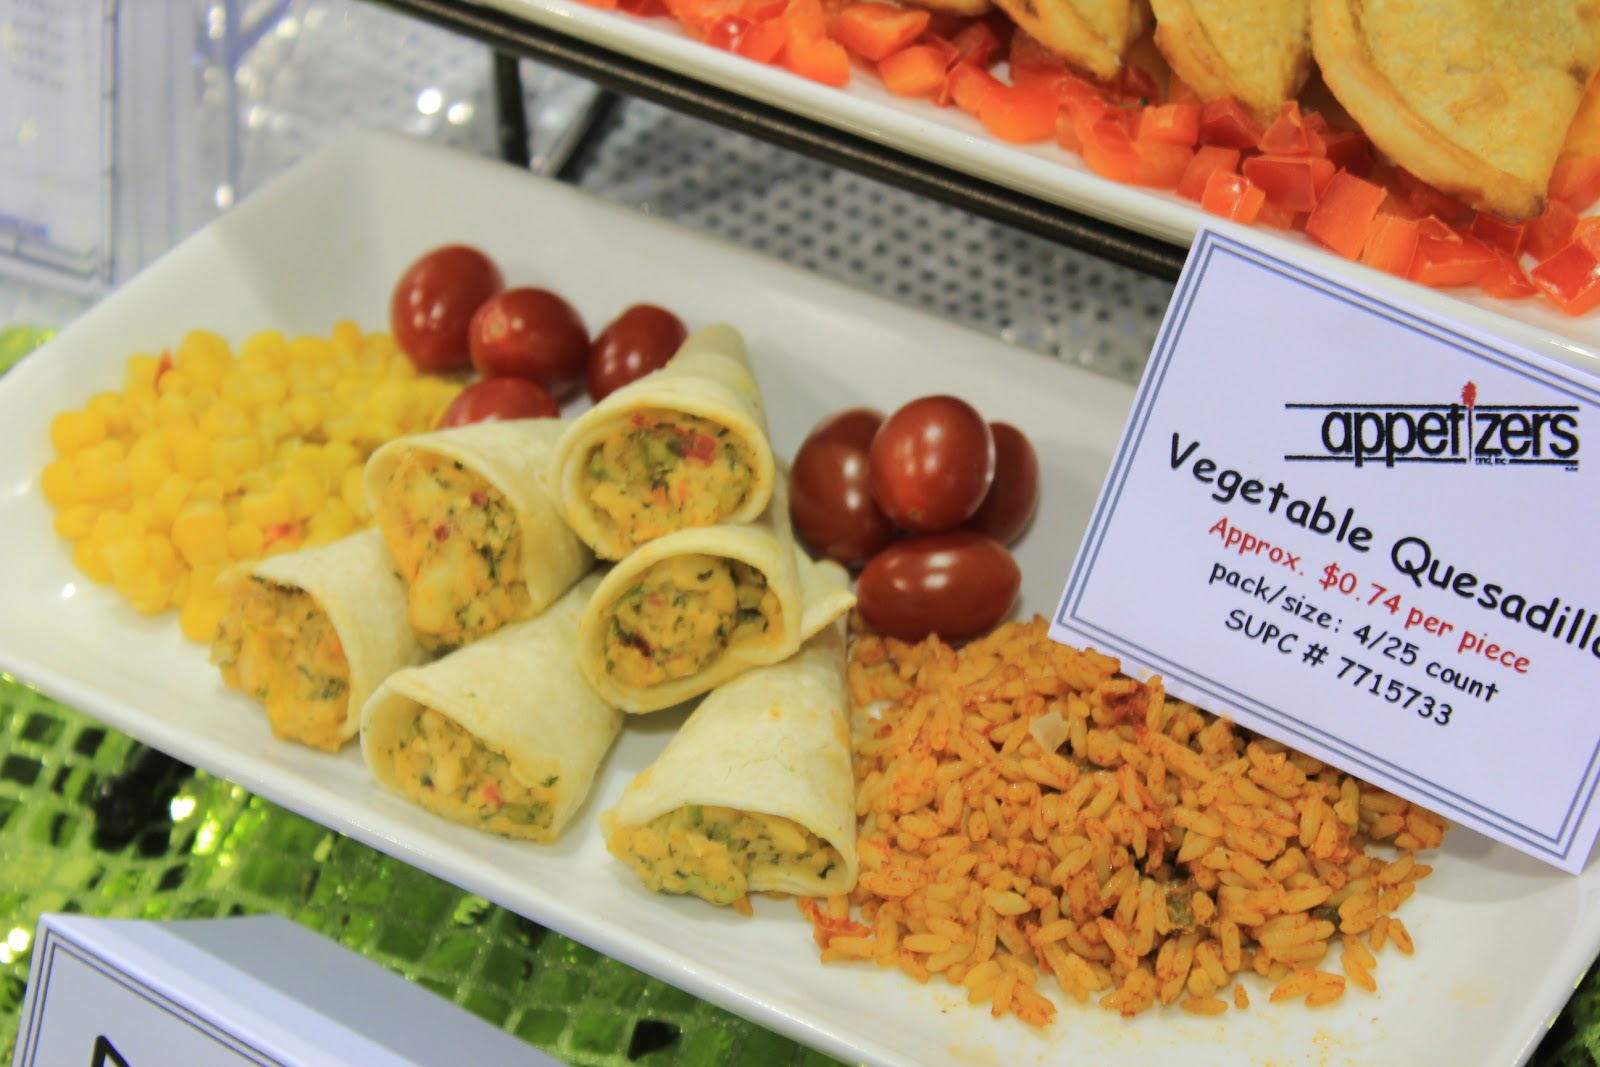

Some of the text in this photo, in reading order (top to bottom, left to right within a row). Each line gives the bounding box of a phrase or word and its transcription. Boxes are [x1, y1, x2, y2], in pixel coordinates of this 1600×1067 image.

[1321, 381, 1579, 467] appetizers
[1169, 432, 1373, 552] Vegetable
[1209, 517, 1531, 674] Approx. $0.74 per piece
[1209, 562, 1499, 703] pack/size: 4/25 count
[1225, 608, 1453, 726] SUPC # 7715733
